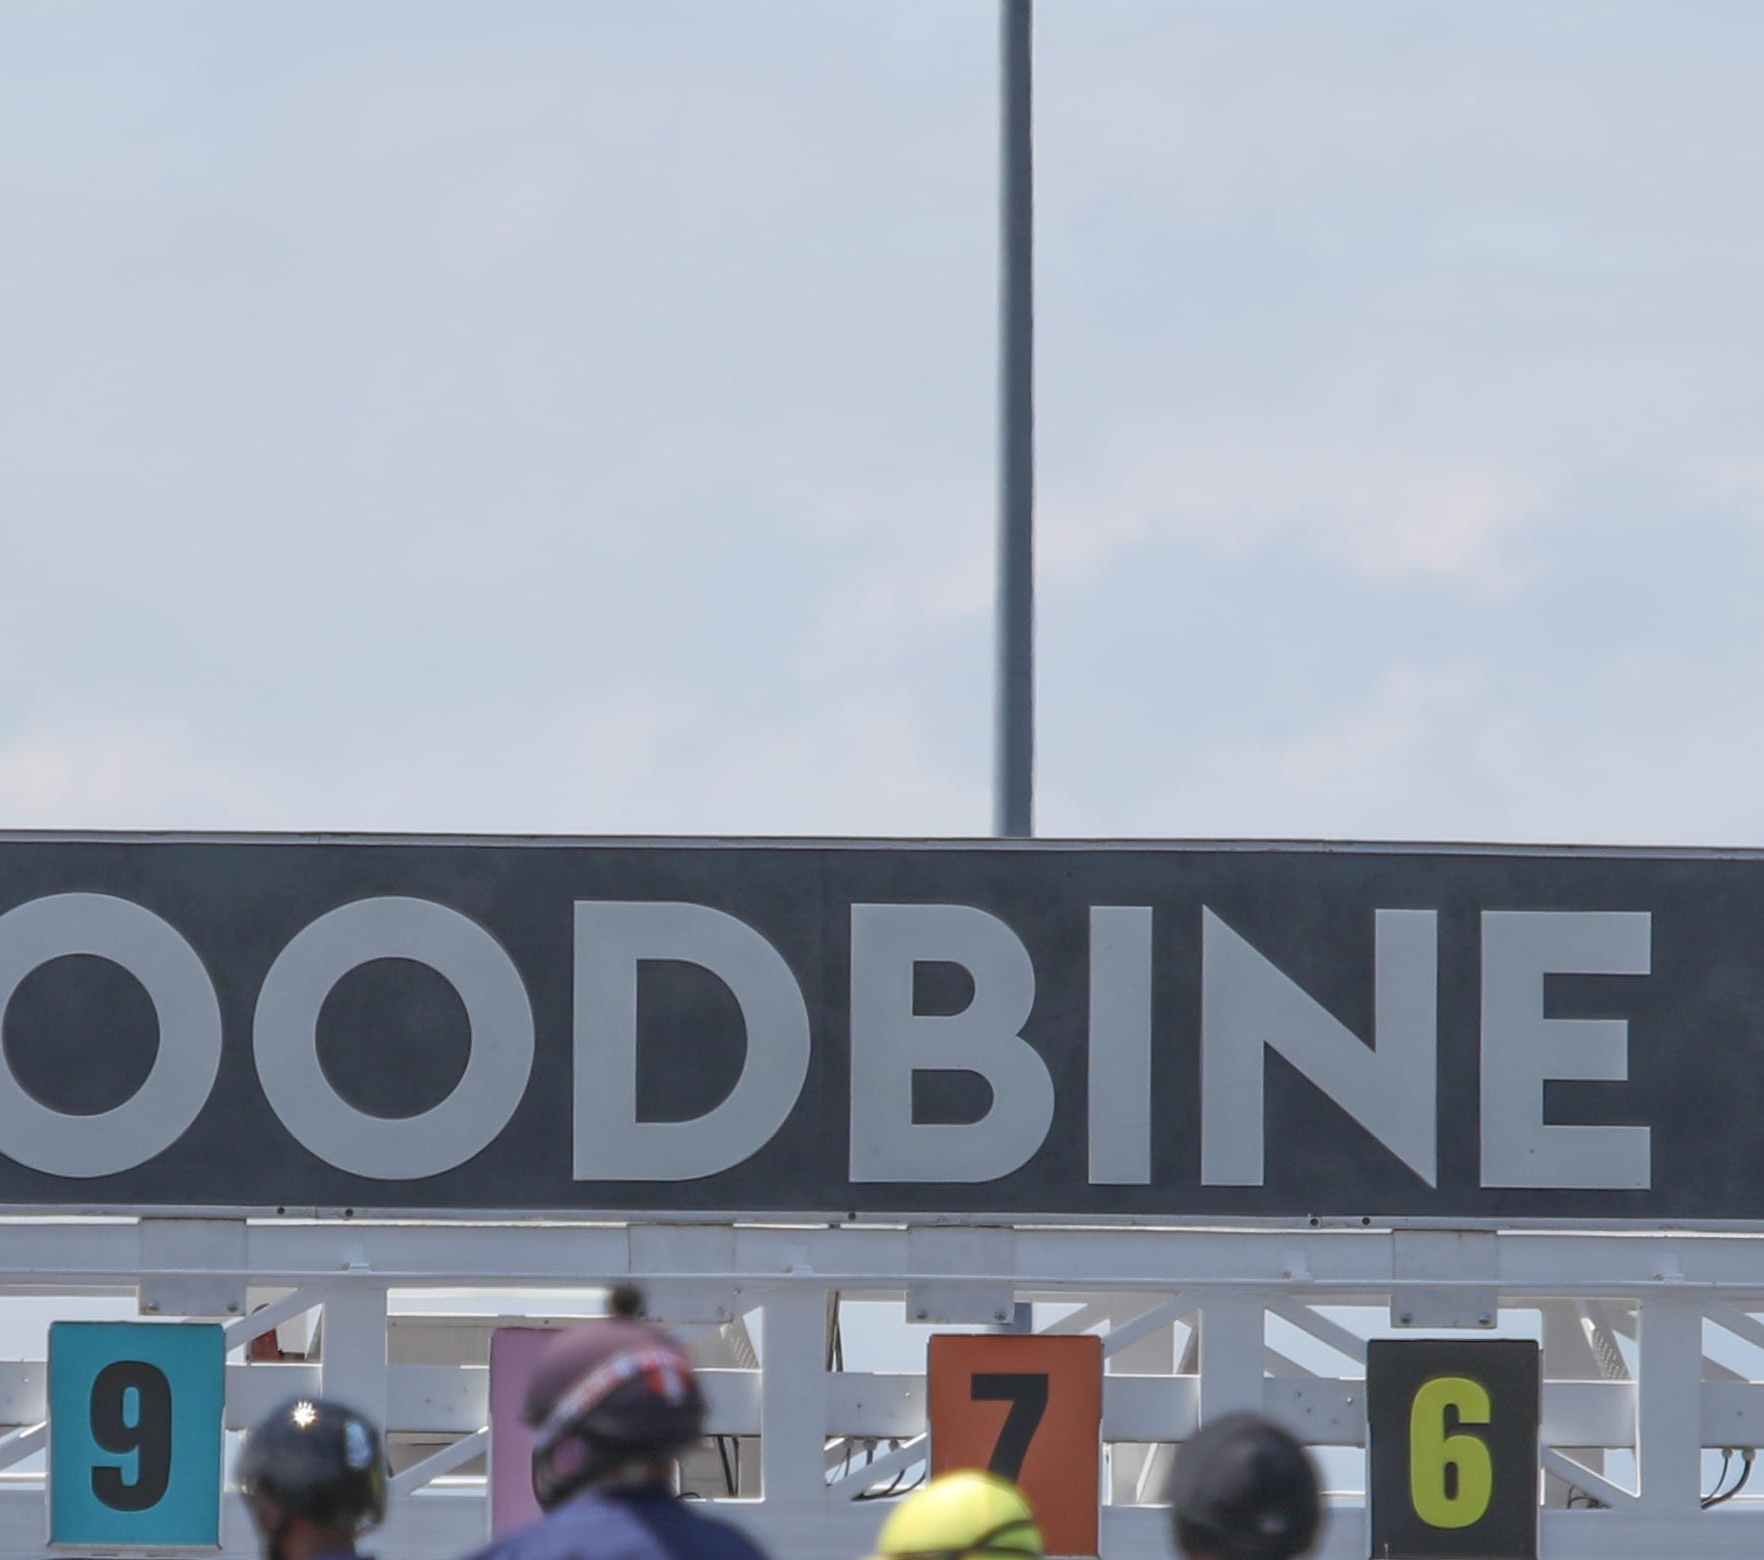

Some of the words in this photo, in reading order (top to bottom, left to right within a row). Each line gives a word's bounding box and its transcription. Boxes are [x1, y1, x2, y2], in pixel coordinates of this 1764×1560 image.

[89, 1360, 173, 1512] 9
[969, 1372, 1050, 1483] 7
[1409, 1376, 1493, 1529] 6
